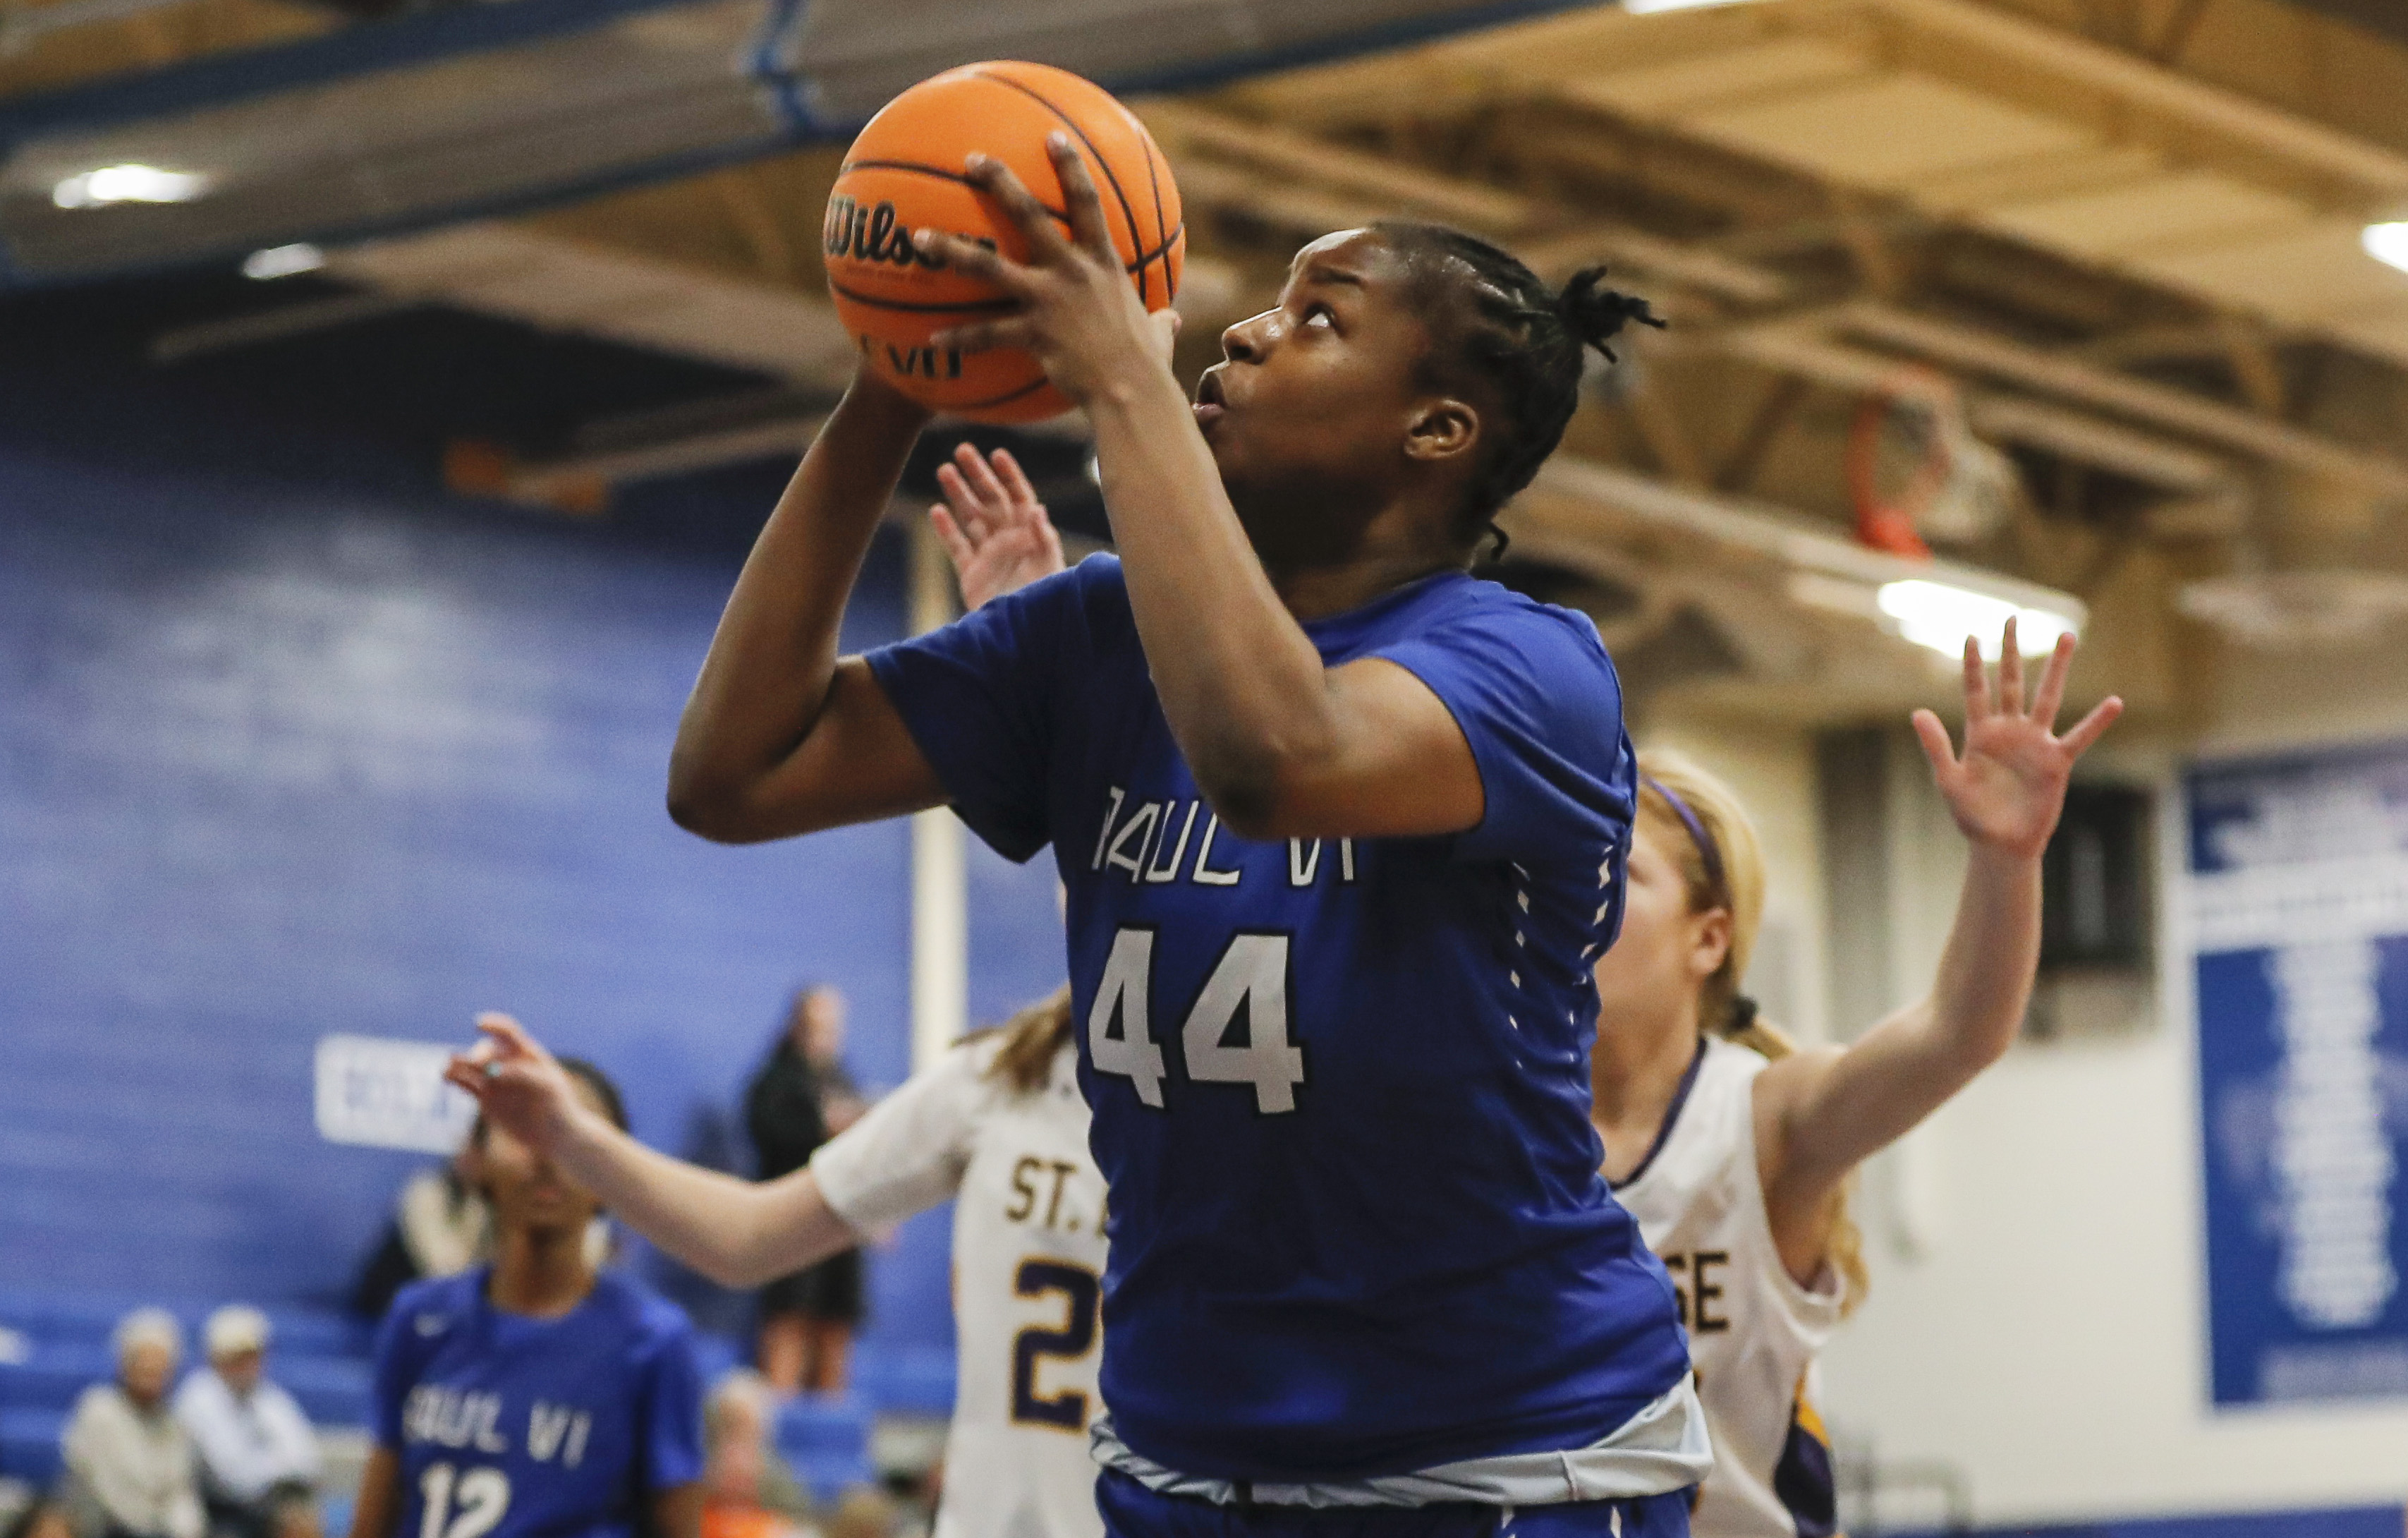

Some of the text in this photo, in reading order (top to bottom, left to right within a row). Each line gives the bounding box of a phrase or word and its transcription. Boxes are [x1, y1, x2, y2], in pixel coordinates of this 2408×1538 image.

[824, 193, 997, 271] Wils
[1091, 785, 1241, 885] PAUL
[1088, 927, 1305, 1115] 44
[1004, 1154, 1081, 1233] ST.
[527, 1399, 592, 1472] VI
[419, 1460, 513, 1538] 12
